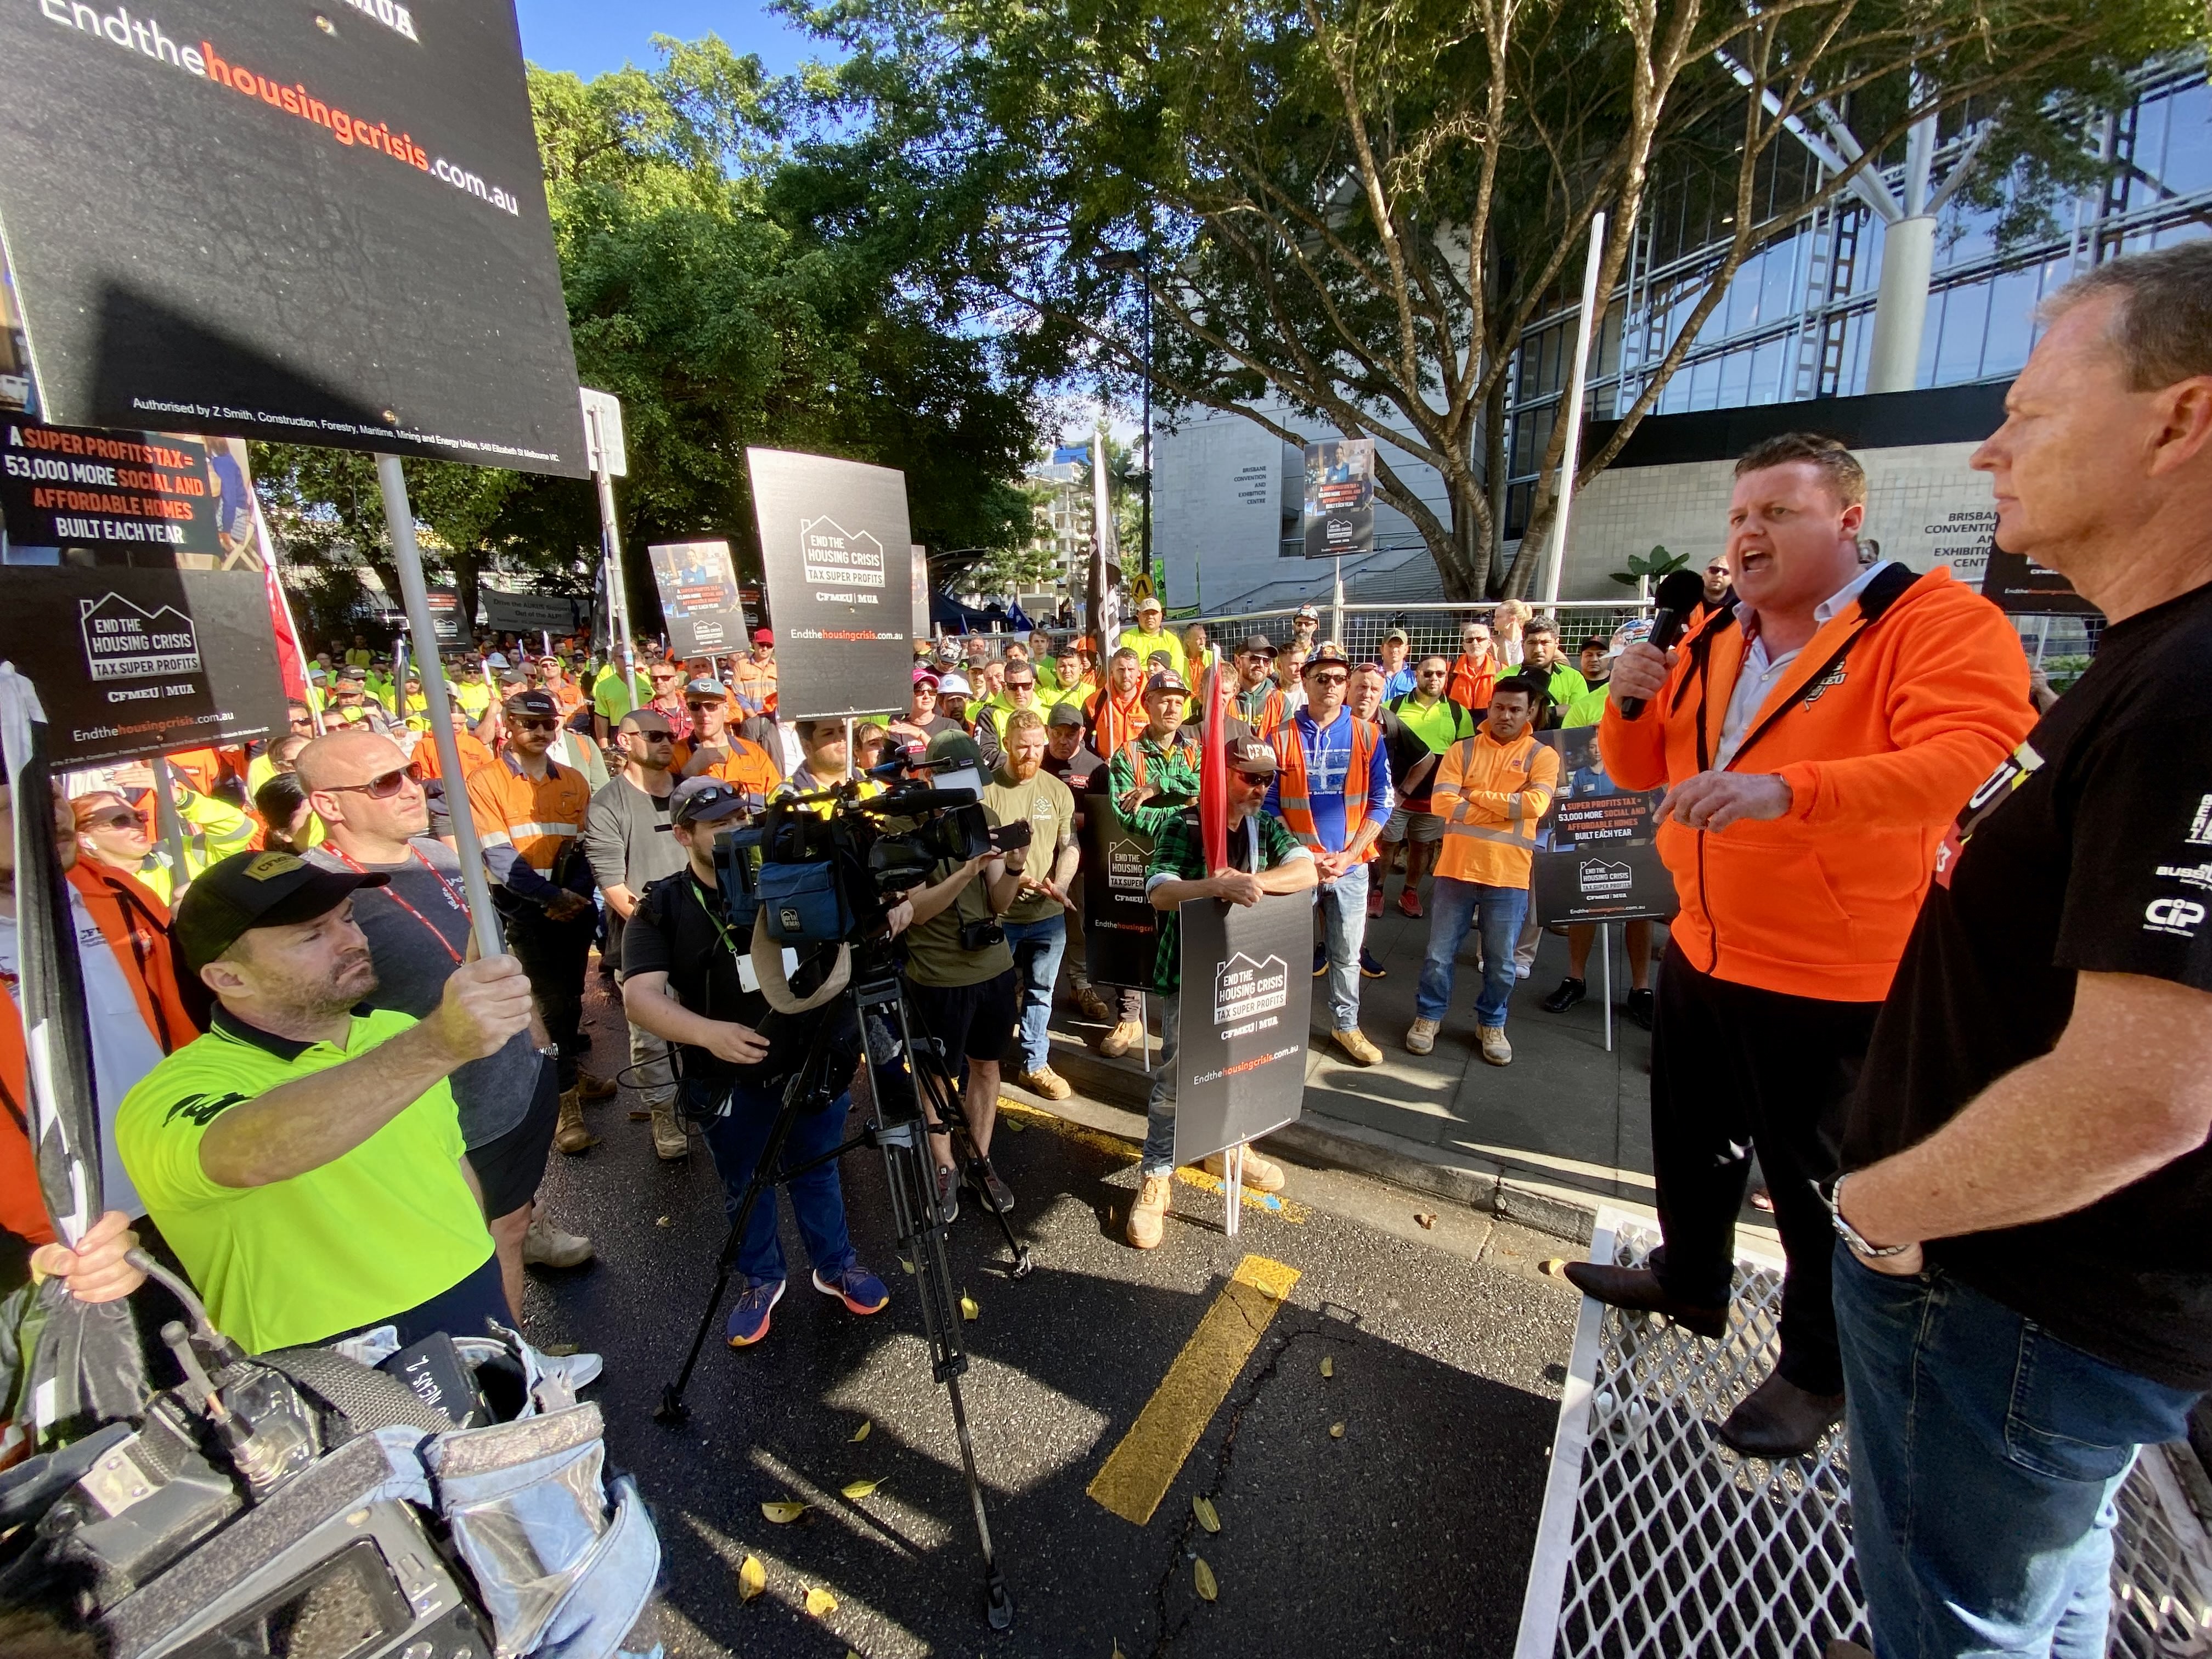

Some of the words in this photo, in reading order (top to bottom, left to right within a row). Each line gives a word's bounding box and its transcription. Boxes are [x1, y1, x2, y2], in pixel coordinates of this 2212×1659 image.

[40, 0, 520, 216] Endthehousingcrisis.com.au
[133, 398, 194, 415] Authorised
[198, 404, 210, 417] by
[212, 406, 221, 417] Z
[223, 408, 256, 421] Smith,
[258, 411, 320, 430] Construction,
[321, 420, 359, 435] Forestry,
[360, 425, 396, 439] Maritime,
[396, 429, 421, 443] Mining
[422, 434, 435, 444] and
[436, 435, 459, 449] Energy
[460, 439, 479, 452] Union,
[480, 443, 492, 452] 540
[492, 444, 517, 456] Elizabeth
[10, 426, 24, 447] A
[24, 428, 83, 455] SUPER
[85, 437, 153, 464] PROFITS
[153, 447, 184, 469] TAX
[5, 455, 69, 482] 53,000
[71, 462, 117, 486] MORE
[118, 469, 173, 493] SOCIAL
[176, 476, 204, 496] AND
[1234, 474, 1266, 482] CONVENTION
[33, 488, 142, 515] AFFORDABLE
[143, 498, 193, 520] HOMES
[55, 517, 100, 539] BUILT
[103, 521, 143, 541] EACH
[145, 523, 186, 544] YEAR
[1925, 523, 1996, 534] CONVENTIO
[810, 534, 827, 548] END
[827, 536, 844, 549] THE
[1977, 535, 1994, 543] AN
[808, 548, 849, 564] HOUSING
[851, 552, 880, 567] CRISIS
[1934, 546, 1991, 556] EXHIBITIO
[1954, 558, 1987, 567] CENT
[808, 569, 825, 580] TAX
[826, 572, 851, 582] SUPER
[853, 573, 882, 584] PROFITS
[816, 592, 853, 603] CFMEU
[857, 594, 879, 604] MUA
[94, 619, 119, 633] END
[119, 618, 143, 632] THE
[791, 629, 903, 641] Endthehousingcrisis.com.au
[92, 635, 150, 653] HOUSING
[152, 634, 192, 650] CRISIS
[95, 663, 118, 676] TAX
[119, 661, 154, 674] SUPER
[157, 658, 198, 672] PROFITS
[108, 687, 159, 702] CFMEU
[166, 685, 196, 696] MUA
[73, 712, 234, 742] Endthehousingcrisis.com.au
[1567, 802, 1590, 810] SUPER
[1591, 799, 1621, 808] PROFITS
[1558, 812, 1583, 822] 53,000
[1584, 810, 1603, 820] MORE
[1604, 809, 1629, 817] SOCIAL
[1567, 820, 1612, 831] AFFORDABLE
[1575, 832, 1593, 840] BUILT
[1595, 830, 1613, 839] EACH
[1613, 828, 1632, 837] YEAR
[1115, 853, 1127, 862] END
[1128, 854, 1141, 862] THE
[1112, 863, 1143, 873] HOUSING
[1124, 879, 1143, 887] SUPER
[1115, 894, 1143, 903] CFMEU
[1094, 919, 1153, 933] Endthehousingcri
[1223, 974, 1238, 986] END
[1239, 969, 1254, 983] THE
[1219, 982, 1255, 1002] HOUSING
[1257, 974, 1283, 992] CRISIS
[1217, 1008, 1231, 1020] TAX
[1232, 1002, 1255, 1015] SUPER
[1257, 994, 1284, 1009] PROFITS
[1221, 1022, 1255, 1040] CFMEU
[1259, 1016, 1278, 1030] MUA
[1194, 1045, 1299, 1085] Endthehousingcrisis.com.au
[413, 1372, 442, 1405] NEWS
